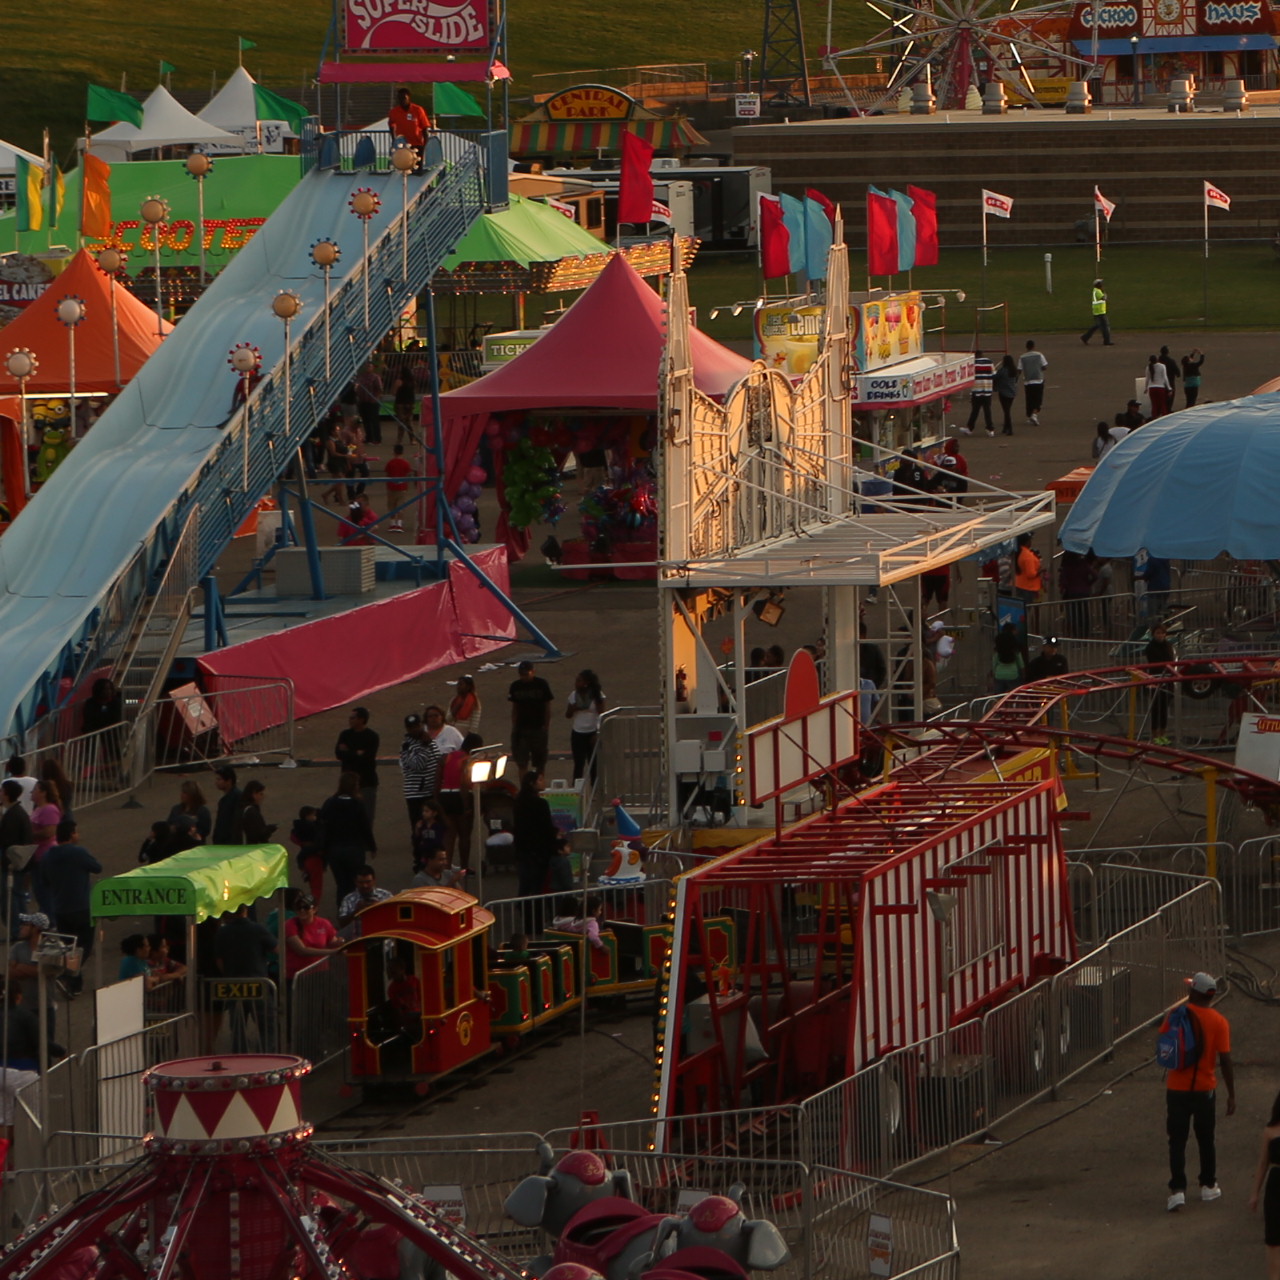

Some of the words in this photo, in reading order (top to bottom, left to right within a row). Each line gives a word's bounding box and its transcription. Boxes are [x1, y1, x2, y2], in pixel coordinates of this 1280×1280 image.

[411, 5, 484, 44] SLIDE
[550, 89, 625, 112] CENTRAL
[566, 105, 610, 118] PARK
[491, 345, 530, 356] TICK
[871, 379, 897, 389] COLD
[102, 888, 187, 906] ENTRANCE
[217, 983, 260, 997] EXIT
